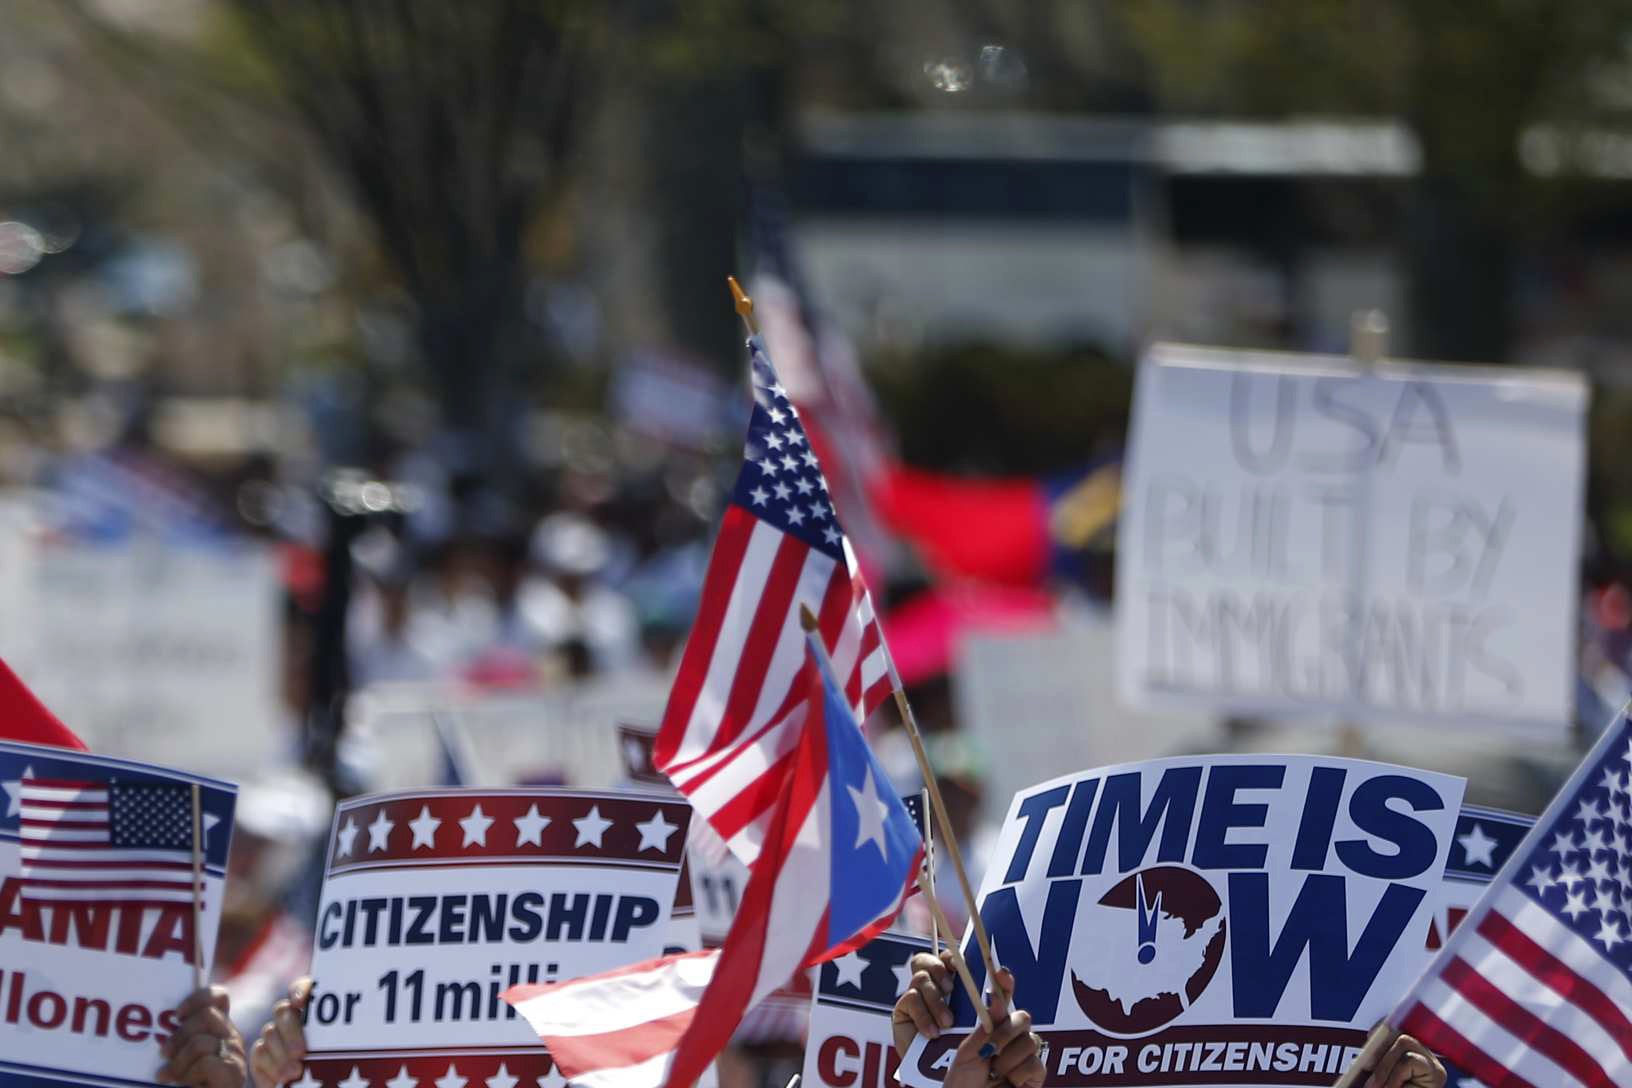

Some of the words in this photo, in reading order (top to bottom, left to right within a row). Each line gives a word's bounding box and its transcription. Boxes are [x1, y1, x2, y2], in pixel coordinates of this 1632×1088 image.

[1228, 372, 1463, 477] USA
[1001, 764, 1287, 885] TIME
[1293, 766, 1445, 880] IS
[318, 891, 662, 950] CITIZENSHIP
[949, 865, 1428, 1035] NOW
[303, 980, 363, 1027] for
[378, 969, 425, 1024] 11
[1057, 1046, 1129, 1076] FOR
[1135, 1039, 1364, 1076] CITIZENSHIP
